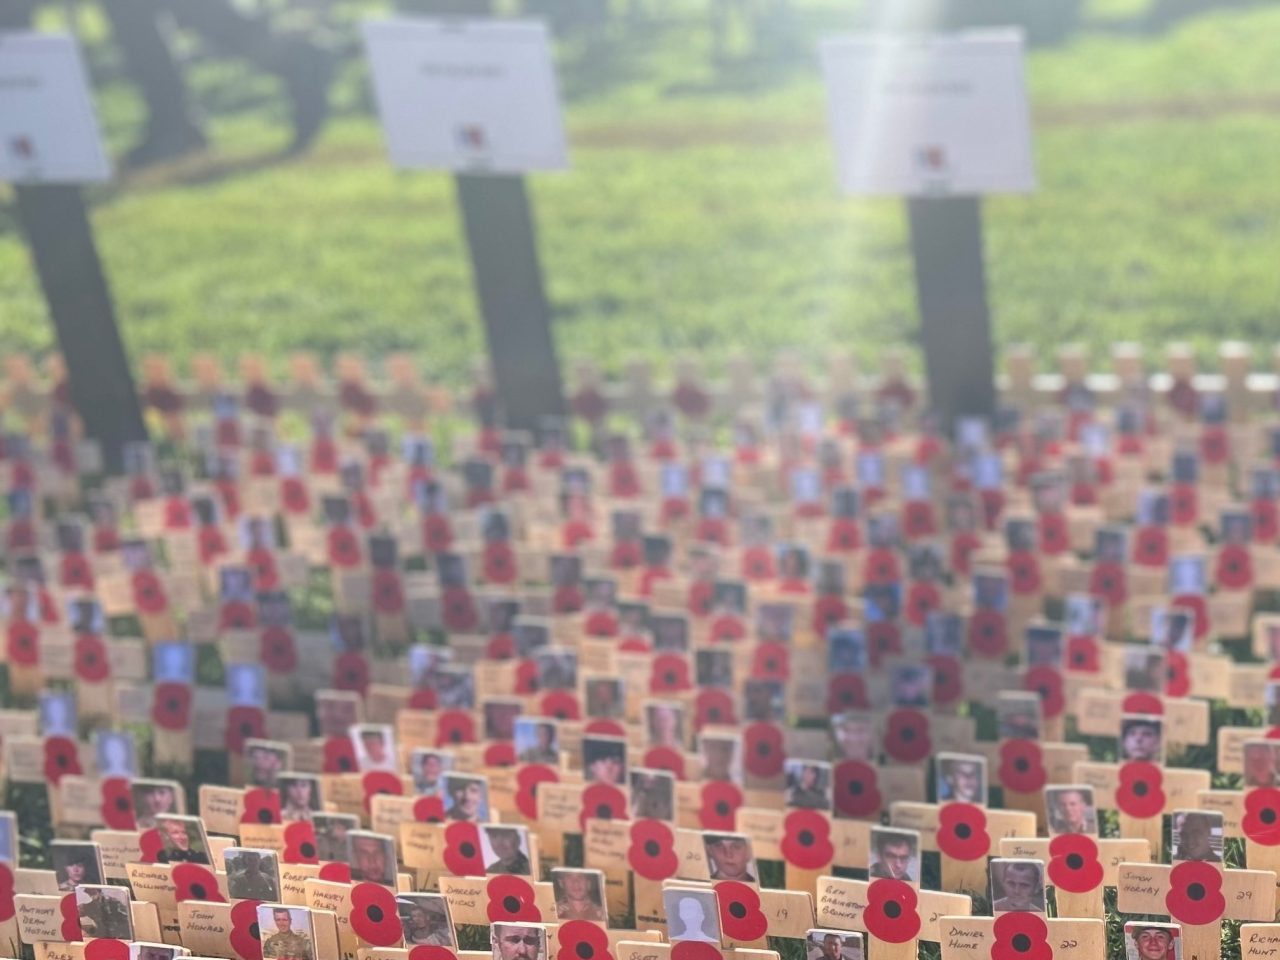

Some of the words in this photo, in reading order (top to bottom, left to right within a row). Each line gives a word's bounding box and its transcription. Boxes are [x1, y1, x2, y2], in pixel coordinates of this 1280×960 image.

[131, 870, 168, 881] RICHARD
[445, 884, 481, 896] DARREN
[1123, 884, 1159, 896] HORNBY
[312, 890, 344, 901] HARVEY
[1236, 891, 1252, 900] 29
[190, 910, 215, 921] JOHN
[776, 909, 788, 919] 19
[947, 928, 985, 938] DANIEL
[947, 941, 979, 950] HUME
[1060, 940, 1078, 949] 22
[47, 952, 73, 960] ALEX
[1248, 948, 1277, 956] HUNT
